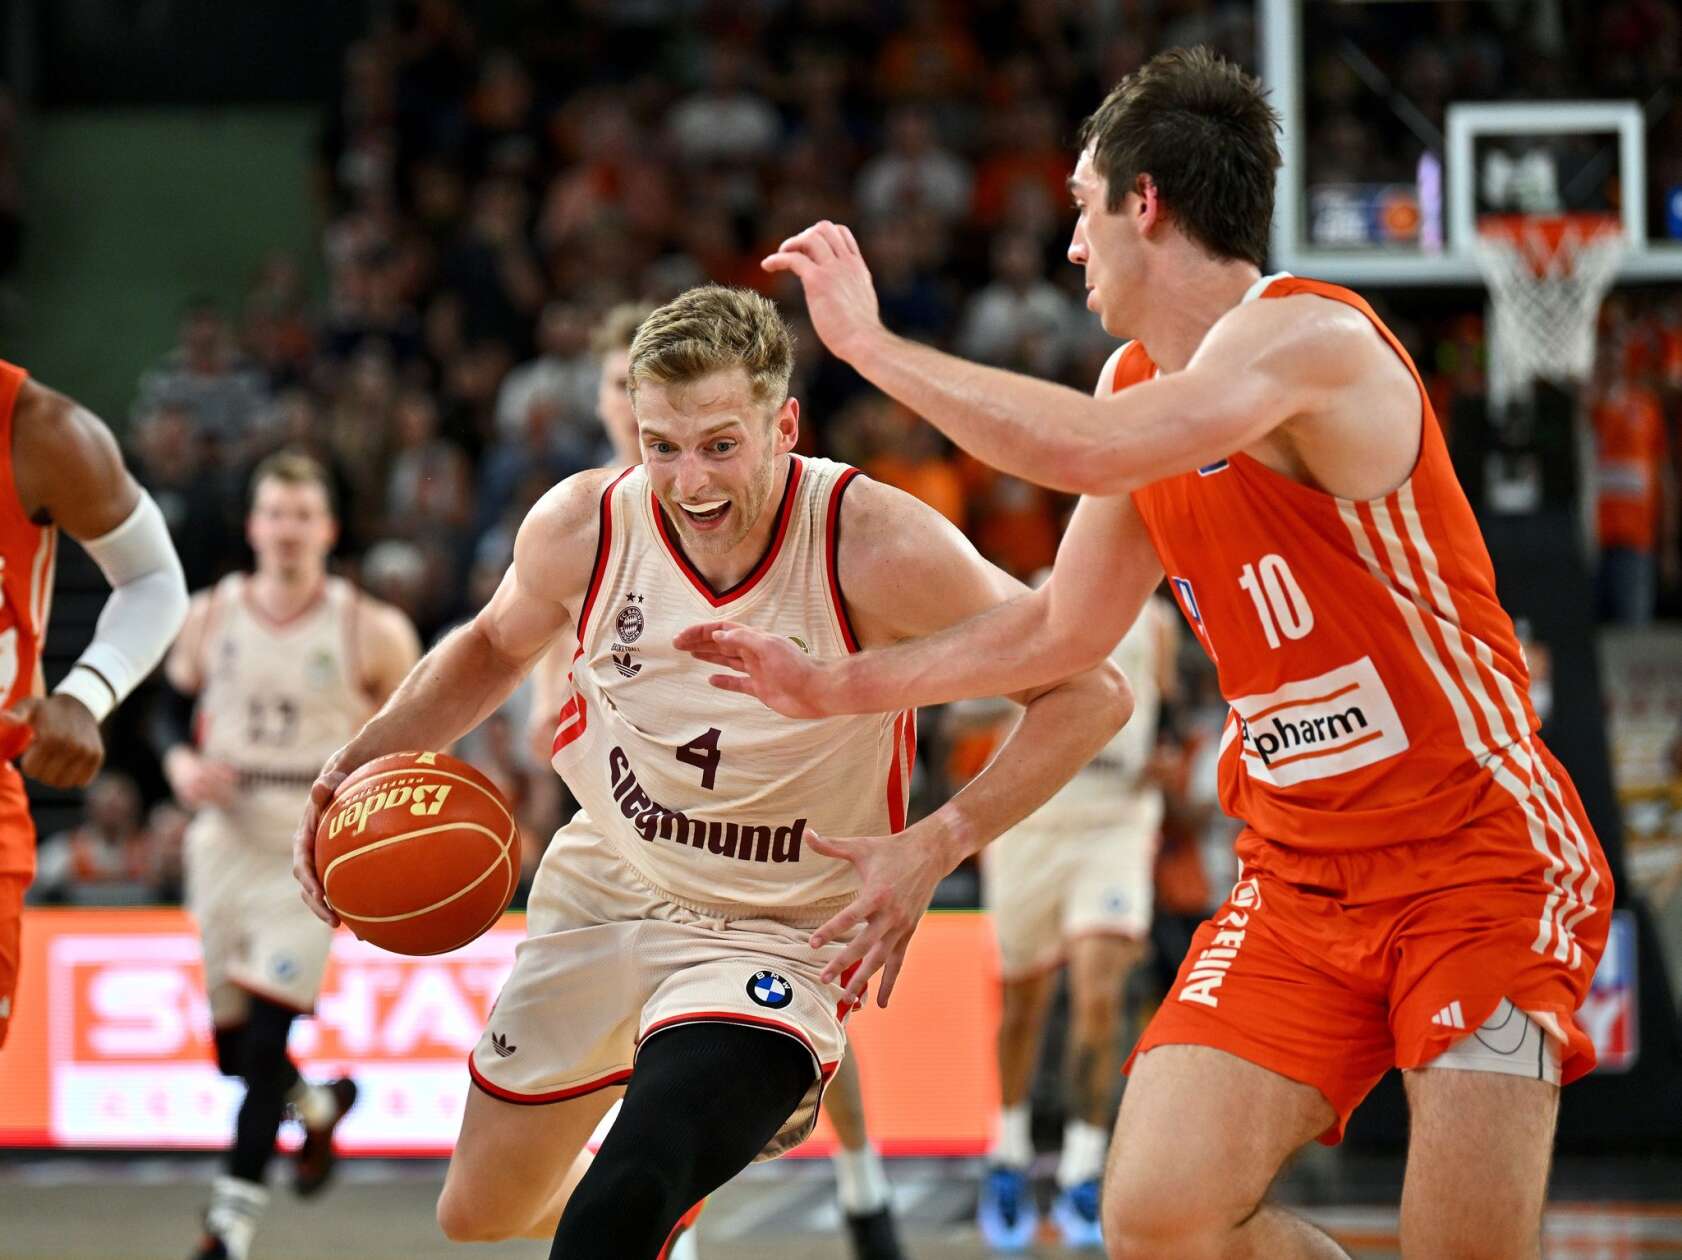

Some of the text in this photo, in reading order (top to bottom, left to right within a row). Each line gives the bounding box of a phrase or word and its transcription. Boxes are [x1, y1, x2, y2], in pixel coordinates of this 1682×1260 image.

[1238, 553, 1315, 650] 10
[675, 727, 722, 791] 4
[328, 784, 453, 840] Baden
[608, 745, 808, 863] Siegmund
[755, 970, 792, 991] BMW
[1178, 909, 1250, 1009] Alliaz
